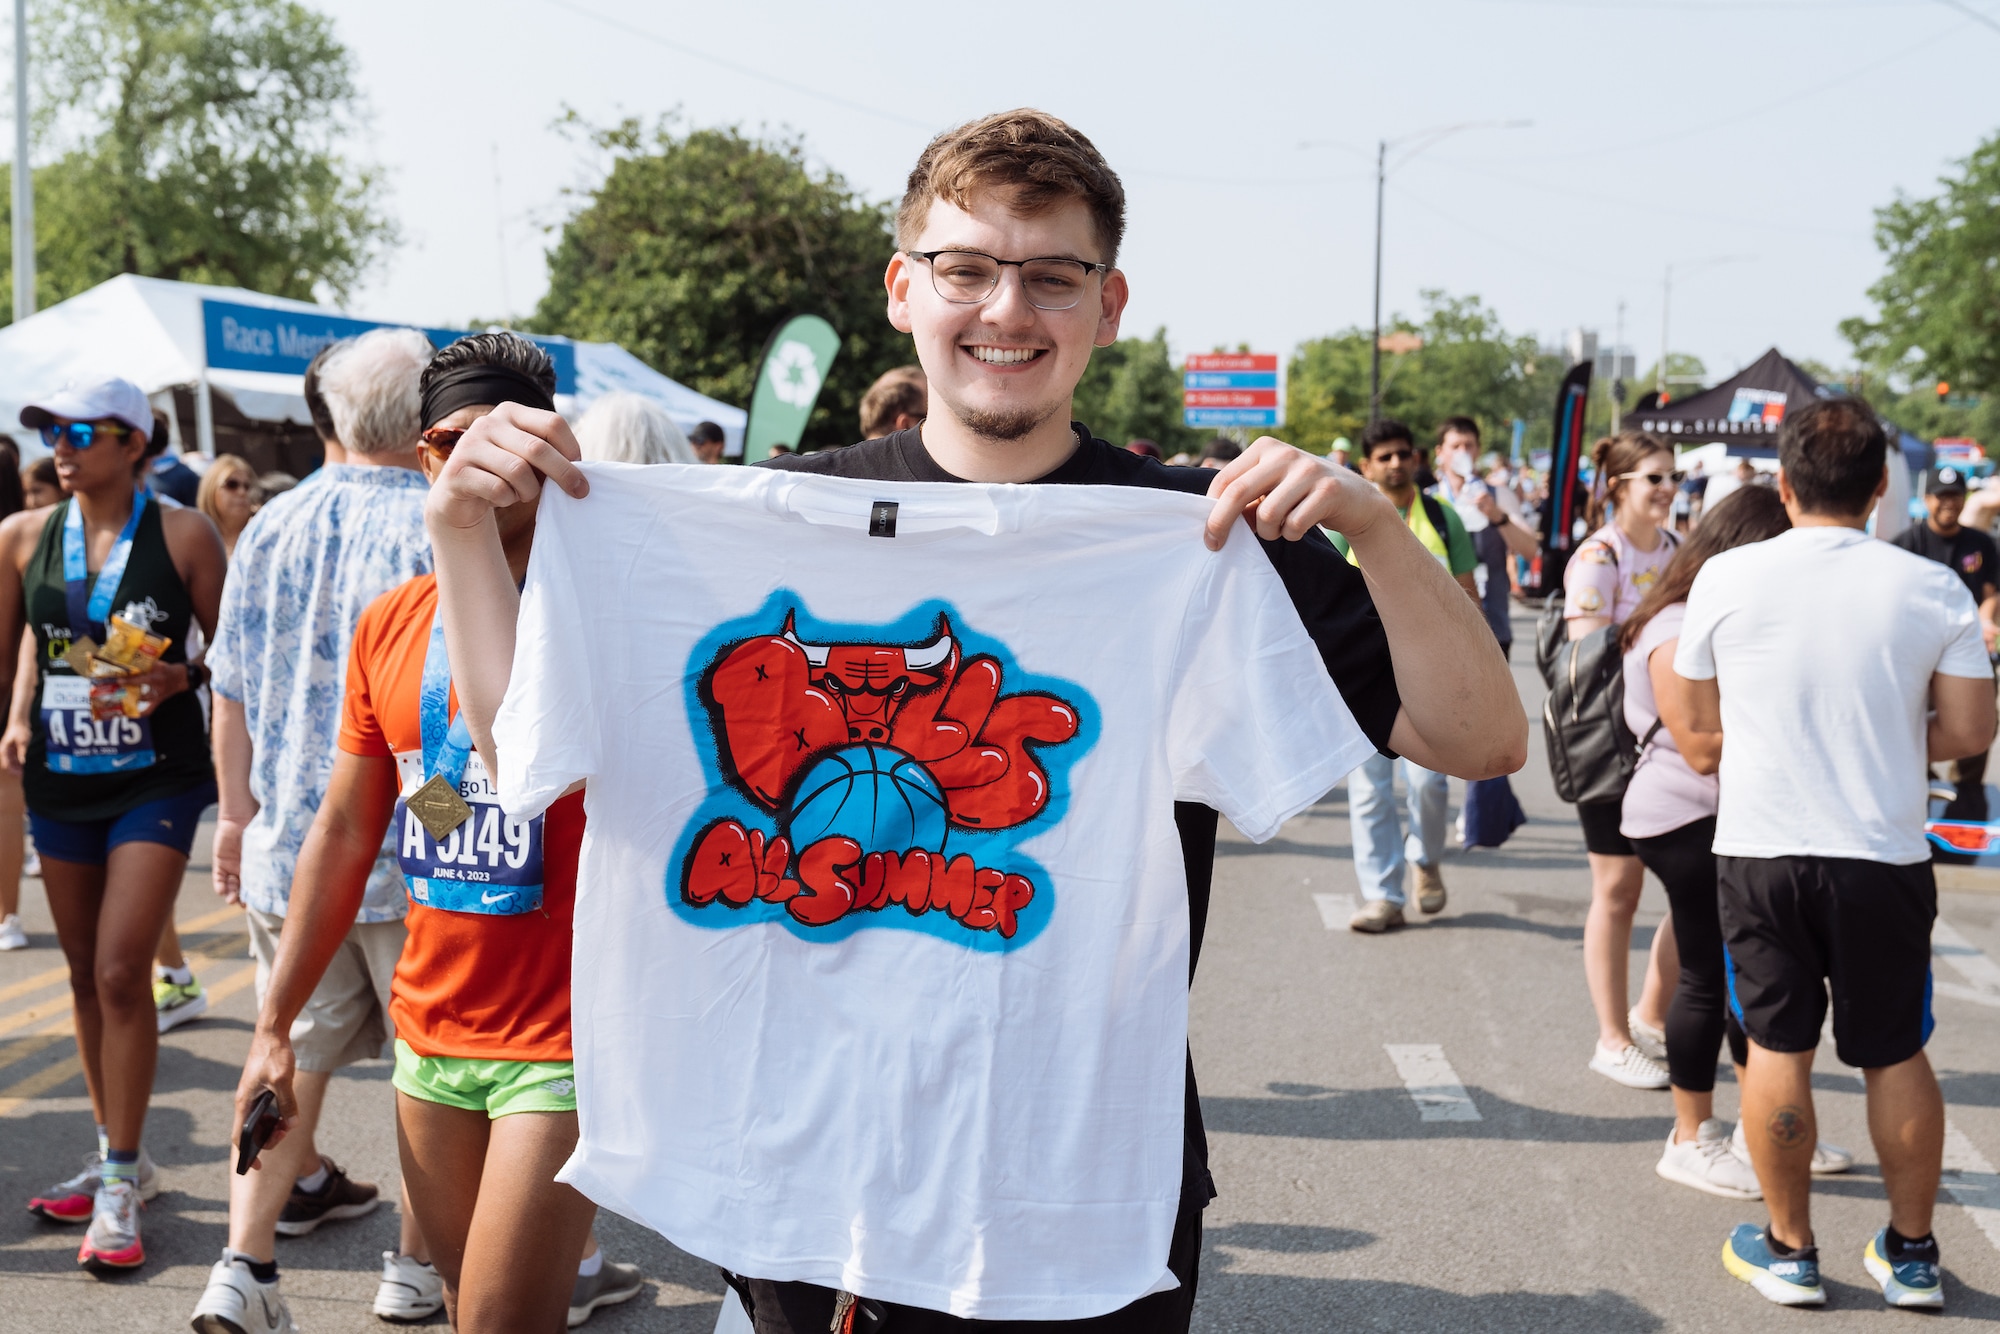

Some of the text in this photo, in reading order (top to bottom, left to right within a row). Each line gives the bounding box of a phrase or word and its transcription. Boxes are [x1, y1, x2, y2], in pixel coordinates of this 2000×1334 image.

[222, 316, 274, 356] Race
[42, 622, 73, 640] Tea
[49, 711, 70, 747] A
[402, 804, 426, 860] A
[432, 867, 491, 882] JUNE 4, 2023
[682, 818, 1035, 938] ALL SUMMER
